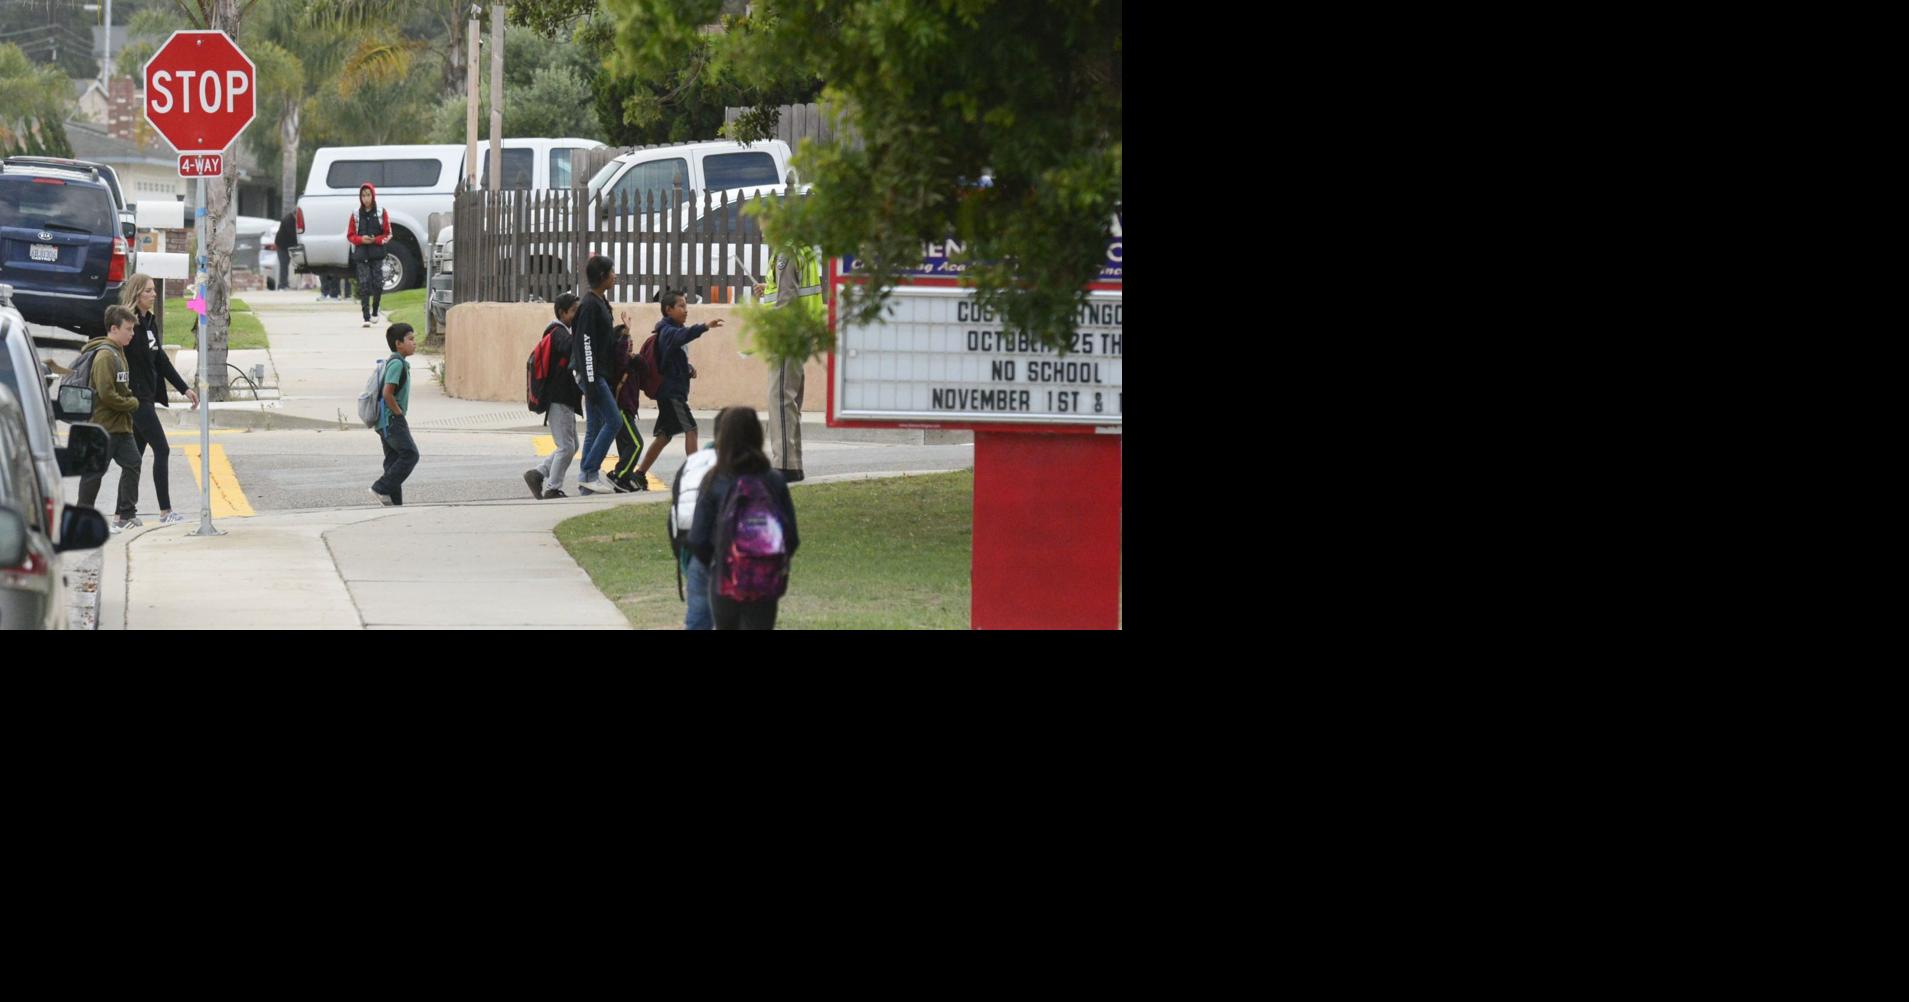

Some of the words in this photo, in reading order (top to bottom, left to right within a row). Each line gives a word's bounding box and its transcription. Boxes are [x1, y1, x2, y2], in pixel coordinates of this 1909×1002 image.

[151, 70, 249, 114] STOP
[181, 158, 219, 172] 4-WAY
[583, 334, 595, 382] SERIOUSLY
[991, 360, 1015, 381] NO
[1028, 361, 1102, 384] SCHOOL
[932, 388, 1030, 411] NOVEMBER
[1048, 391, 1080, 412] 1ST
[1094, 392, 1103, 413] &
